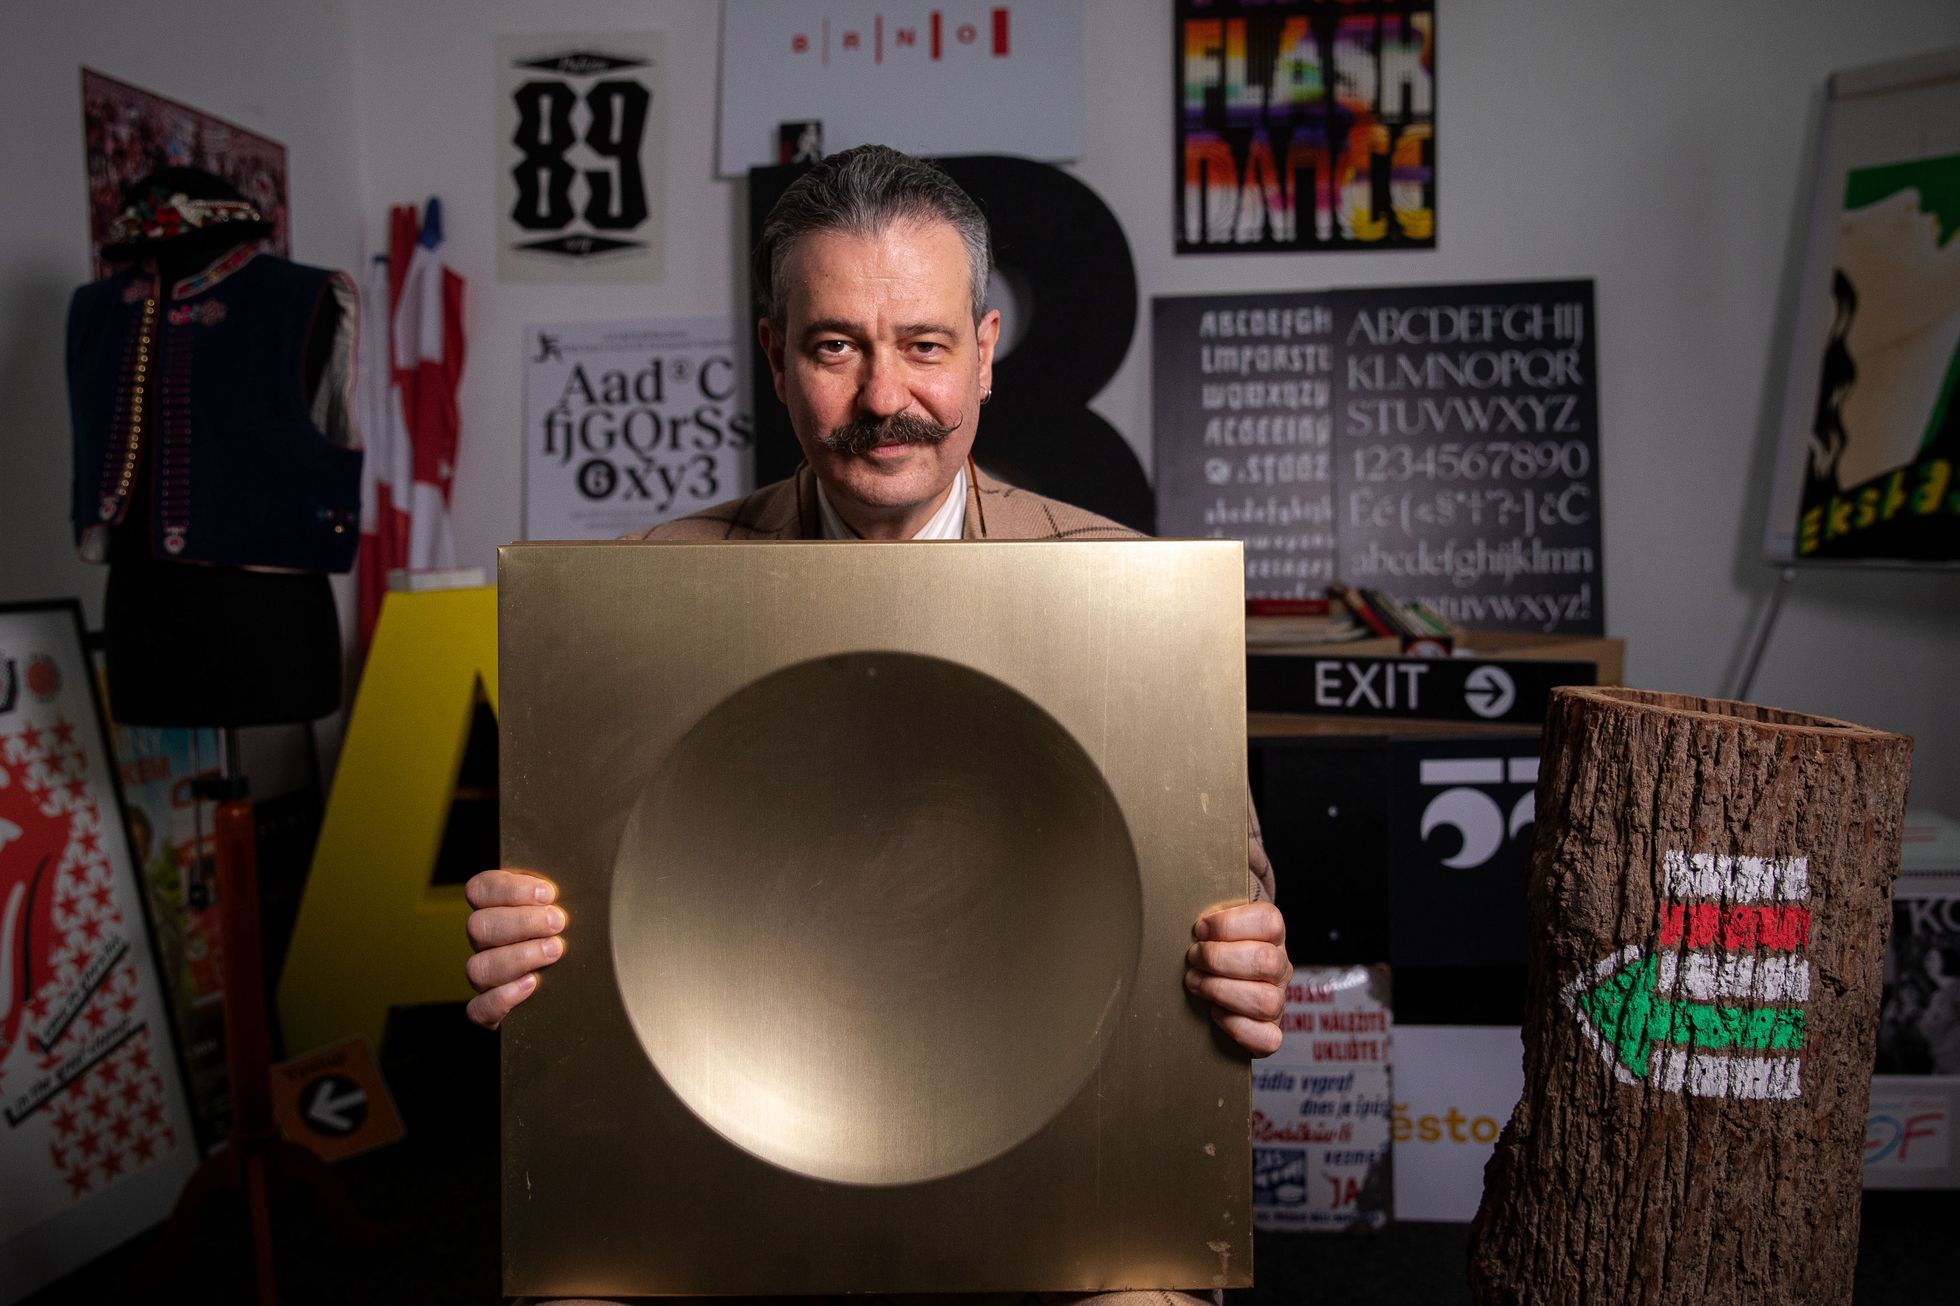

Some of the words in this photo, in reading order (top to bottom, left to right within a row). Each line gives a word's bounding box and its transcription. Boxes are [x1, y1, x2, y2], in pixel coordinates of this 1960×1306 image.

[512, 81, 650, 229] 89
[1346, 302, 1585, 350] ABCDEFGHIJ
[1347, 349, 1585, 391] KLMNOPQR
[1346, 395, 1581, 436] STUVWXYZ
[1354, 440, 1591, 482] 1234567890
[1314, 659, 1430, 711] EXIT
[1391, 1103, 1498, 1142] ěsto
